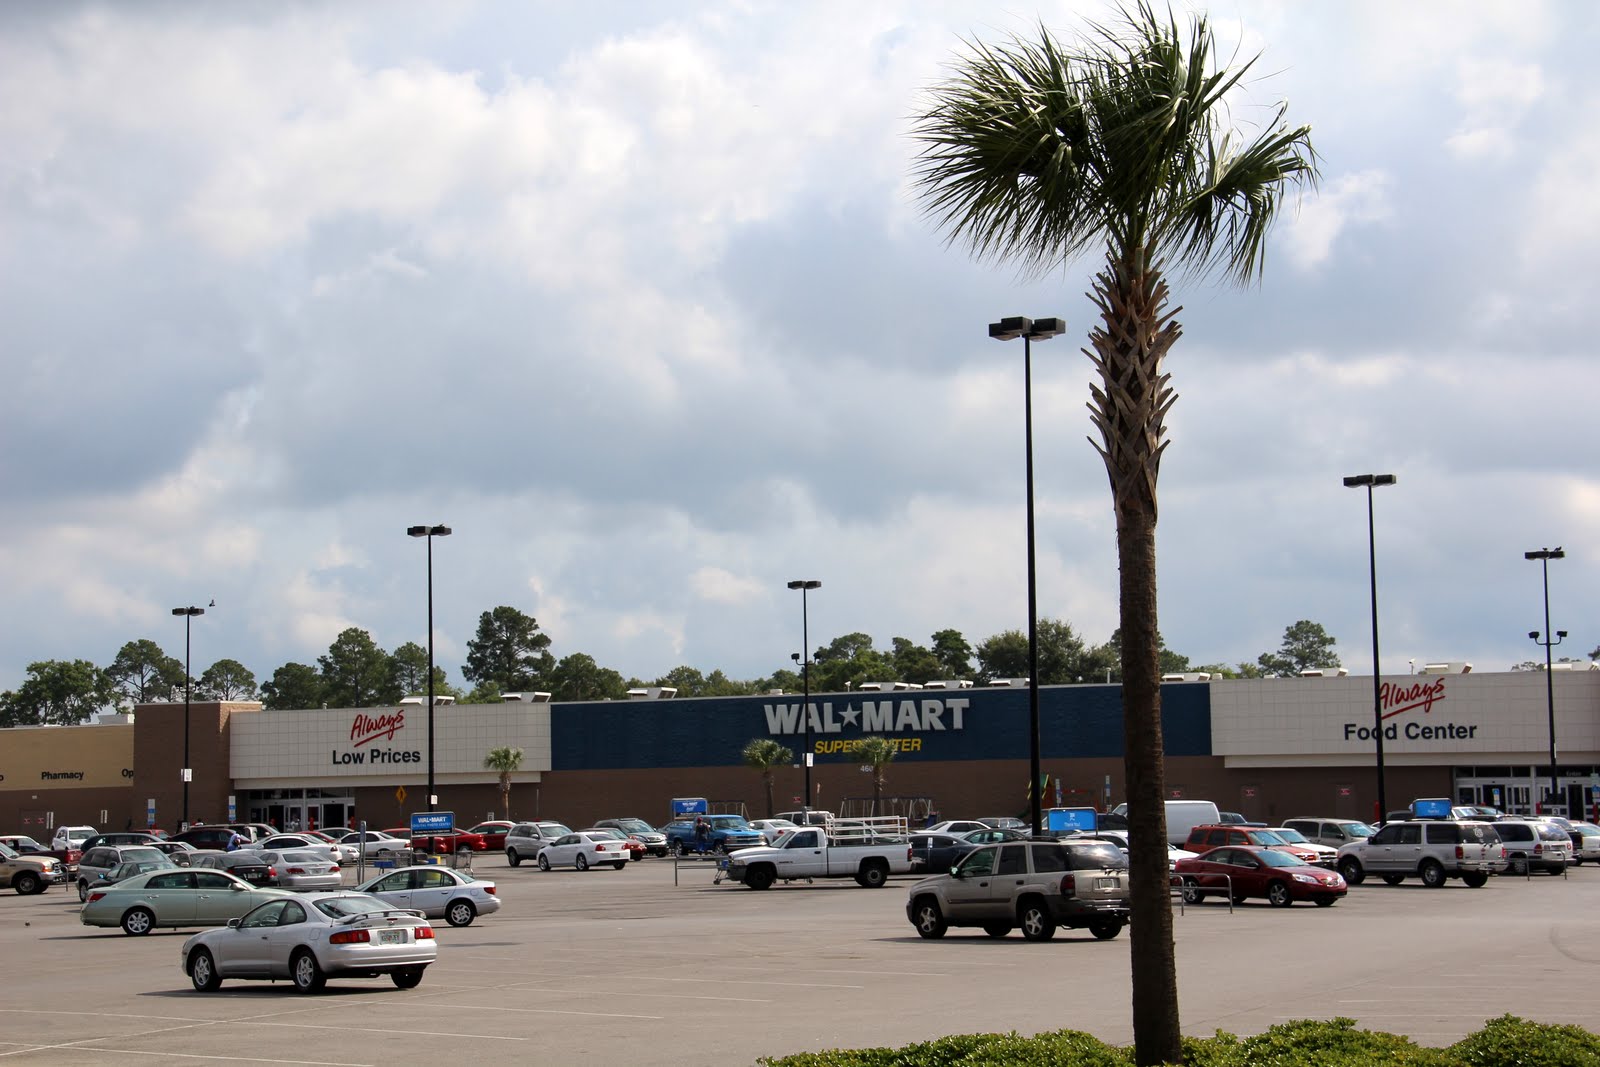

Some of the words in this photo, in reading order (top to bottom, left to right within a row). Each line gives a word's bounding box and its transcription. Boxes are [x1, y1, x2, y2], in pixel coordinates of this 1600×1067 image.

[1379, 677, 1445, 713] Always
[350, 709, 405, 741] Always
[1344, 723, 1398, 741] Food
[1405, 722, 1478, 740] Center
[814, 738, 922, 754] SUPERNTER
[332, 749, 365, 765] Low
[370, 748, 421, 764] Prices
[41, 771, 84, 781] Pharmacy
